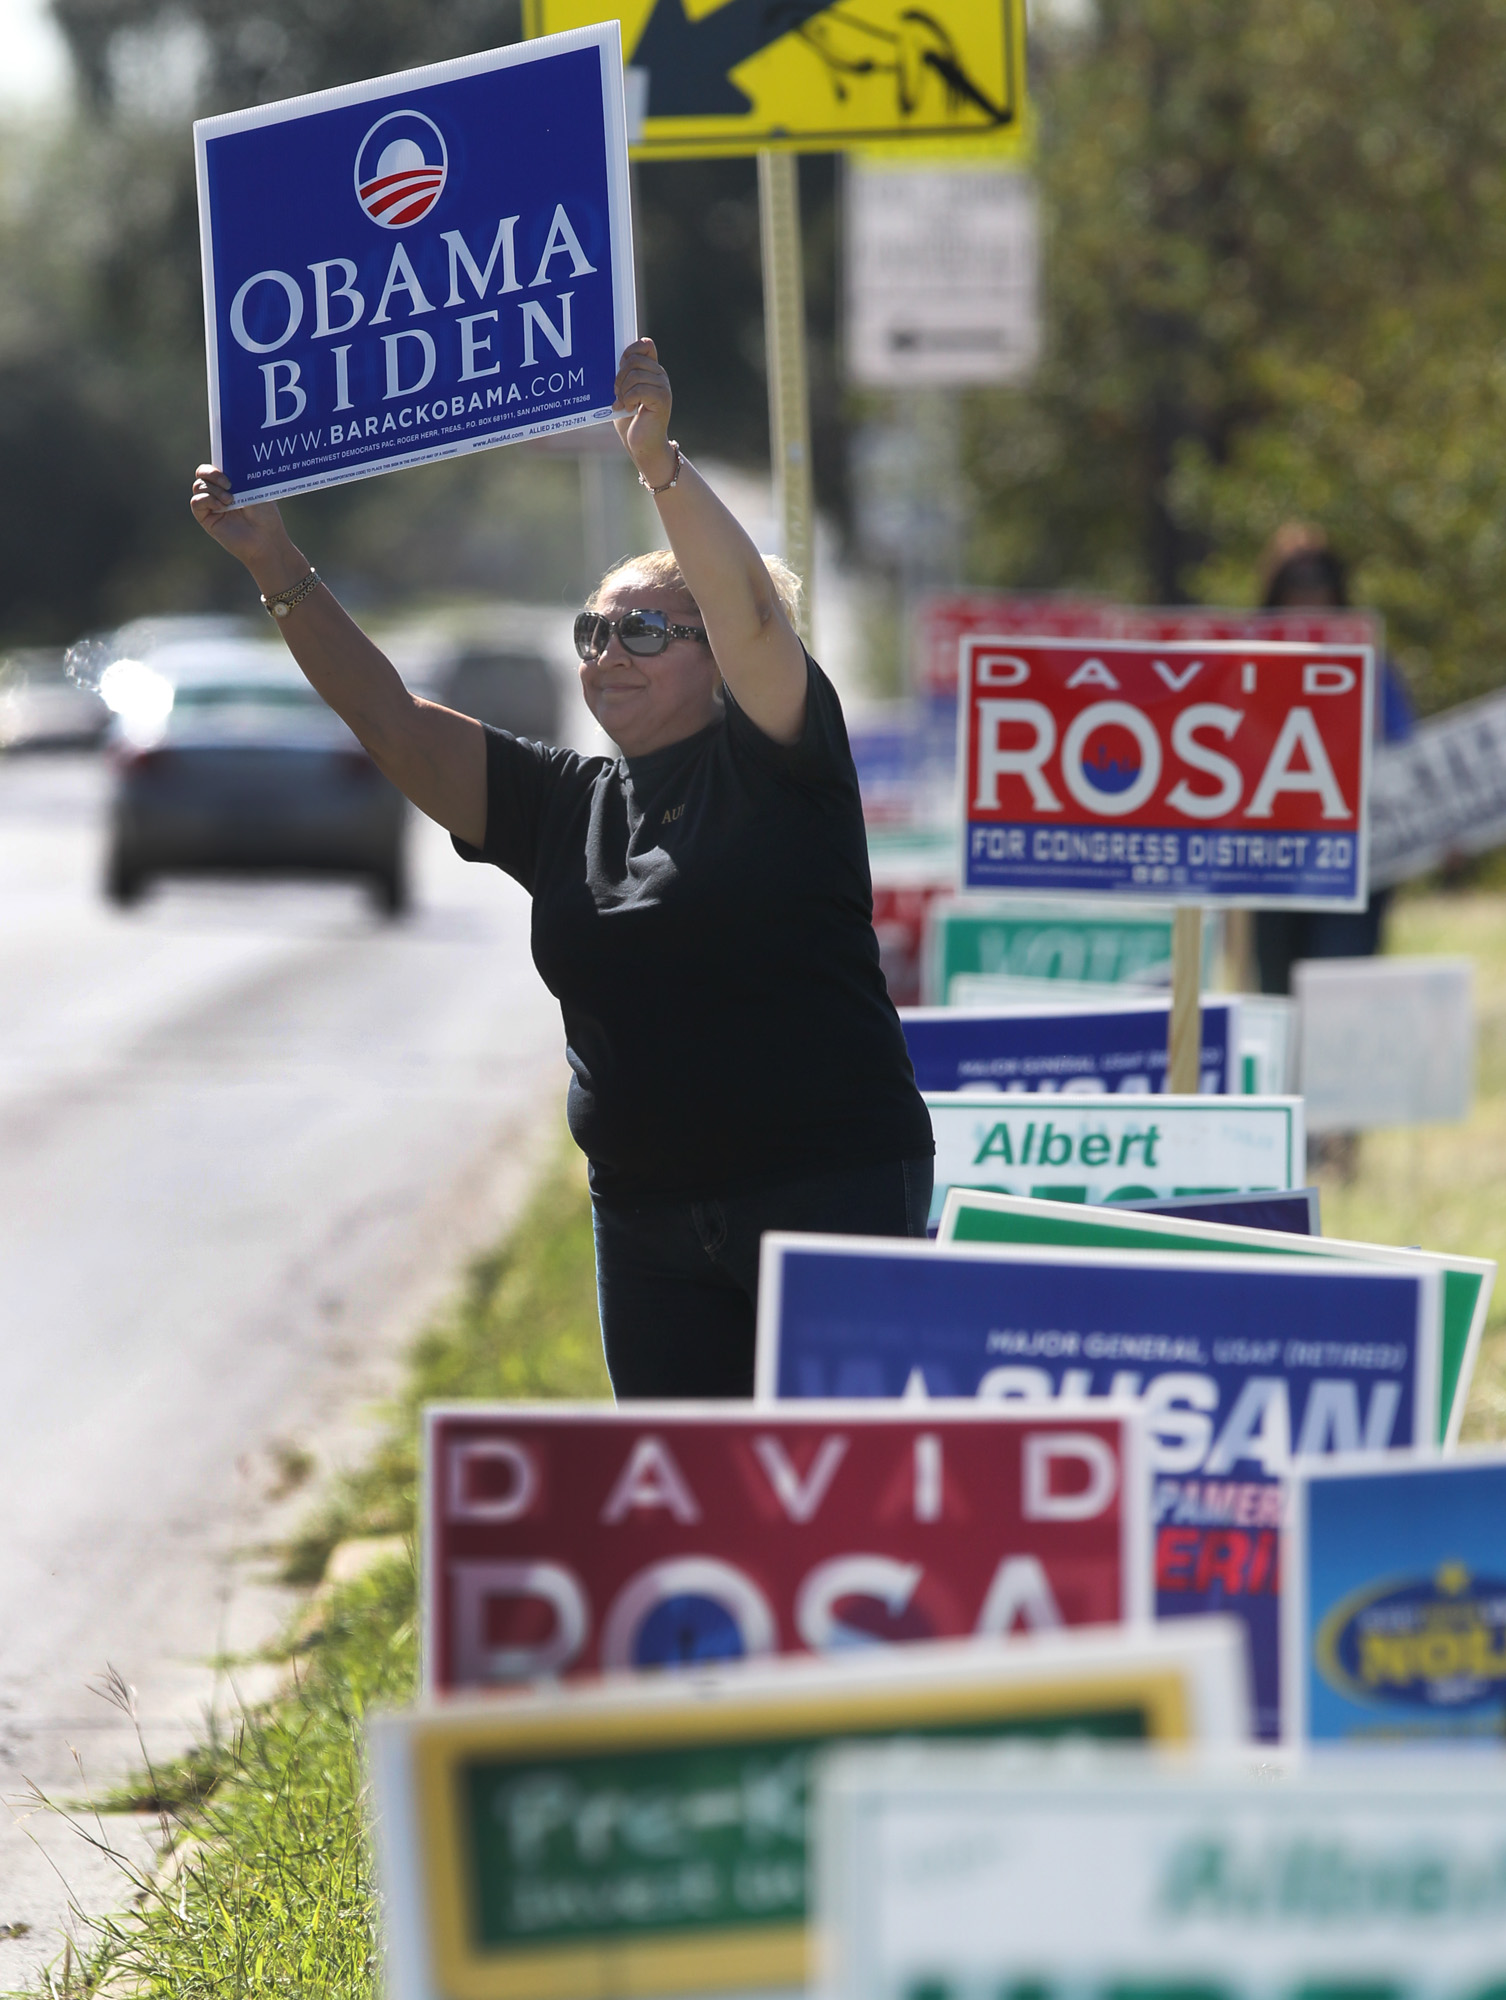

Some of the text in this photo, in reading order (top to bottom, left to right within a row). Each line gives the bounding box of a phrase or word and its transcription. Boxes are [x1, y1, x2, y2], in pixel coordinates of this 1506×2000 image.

[230, 203, 597, 354] OBAMA
[258, 291, 575, 429] BIDEN
[247, 472, 261, 480] PAID
[263, 468, 276, 476] POL.
[278, 465, 291, 473] ADV.
[301, 452, 340, 467] NORTHWEST
[342, 444, 380, 458] DEMOCRATS
[397, 434, 419, 446] ROGER
[479, 416, 492, 425] BOX
[516, 408, 531, 417] SAN
[563, 398, 572, 406] TX
[253, 367, 584, 462] WWW.BARACKOBAMA.COM
[529, 424, 550, 435] ALLIED
[976, 654, 1357, 696] DAVID
[973, 699, 1353, 820] ROSA
[972, 828, 1353, 870] FOR CONGRESS DISTRICT 20
[973, 1122, 1162, 1168] Albert
[986, 1330, 1081, 1357] MAJOR
[447, 1434, 1118, 1523] DAVID
